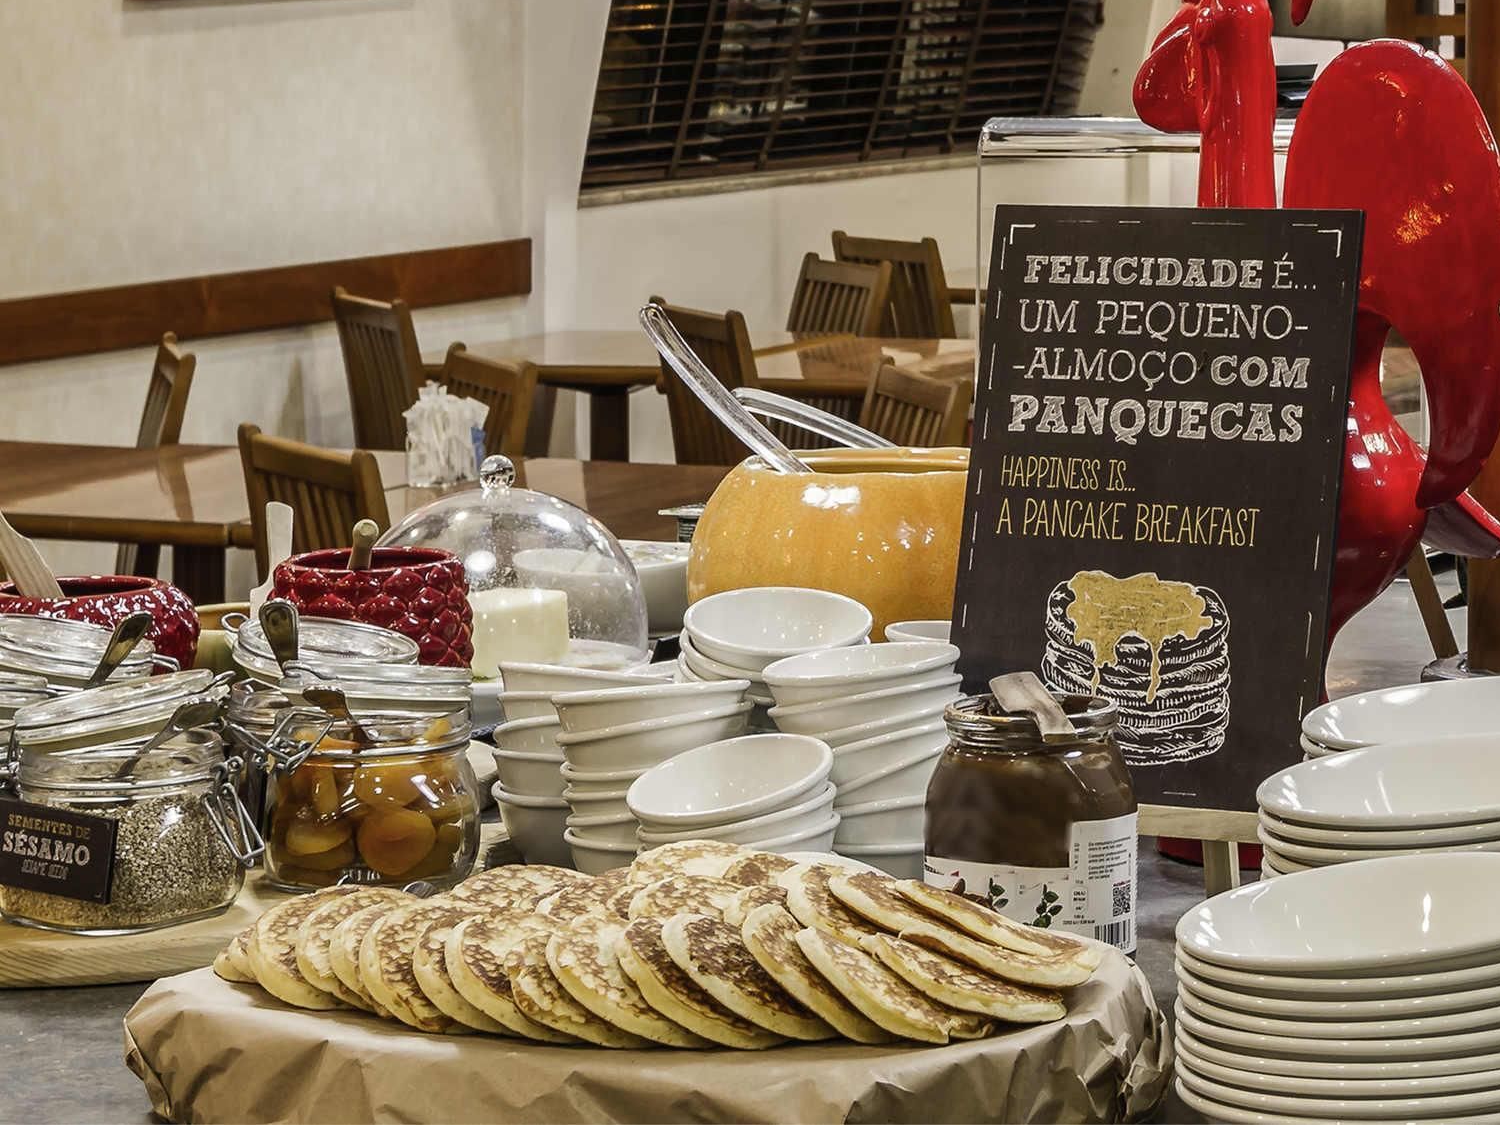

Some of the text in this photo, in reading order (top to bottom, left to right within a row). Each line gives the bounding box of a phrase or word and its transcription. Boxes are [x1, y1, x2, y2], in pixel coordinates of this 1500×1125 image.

[1023, 252, 1317, 290] FELICIDADE É...
[1018, 298, 1309, 342] UM PEQUENO-
[1013, 347, 1311, 392] -ALMOÇO COM
[1008, 394, 1304, 445] PANQUECAS
[1000, 455, 1136, 493] HAPPINESS IS...
[996, 497, 1260, 547] A PANCAKE BREAKFAST
[7, 813, 91, 840] SEMENTES DE
[2, 829, 91, 866] SÉSAMO
